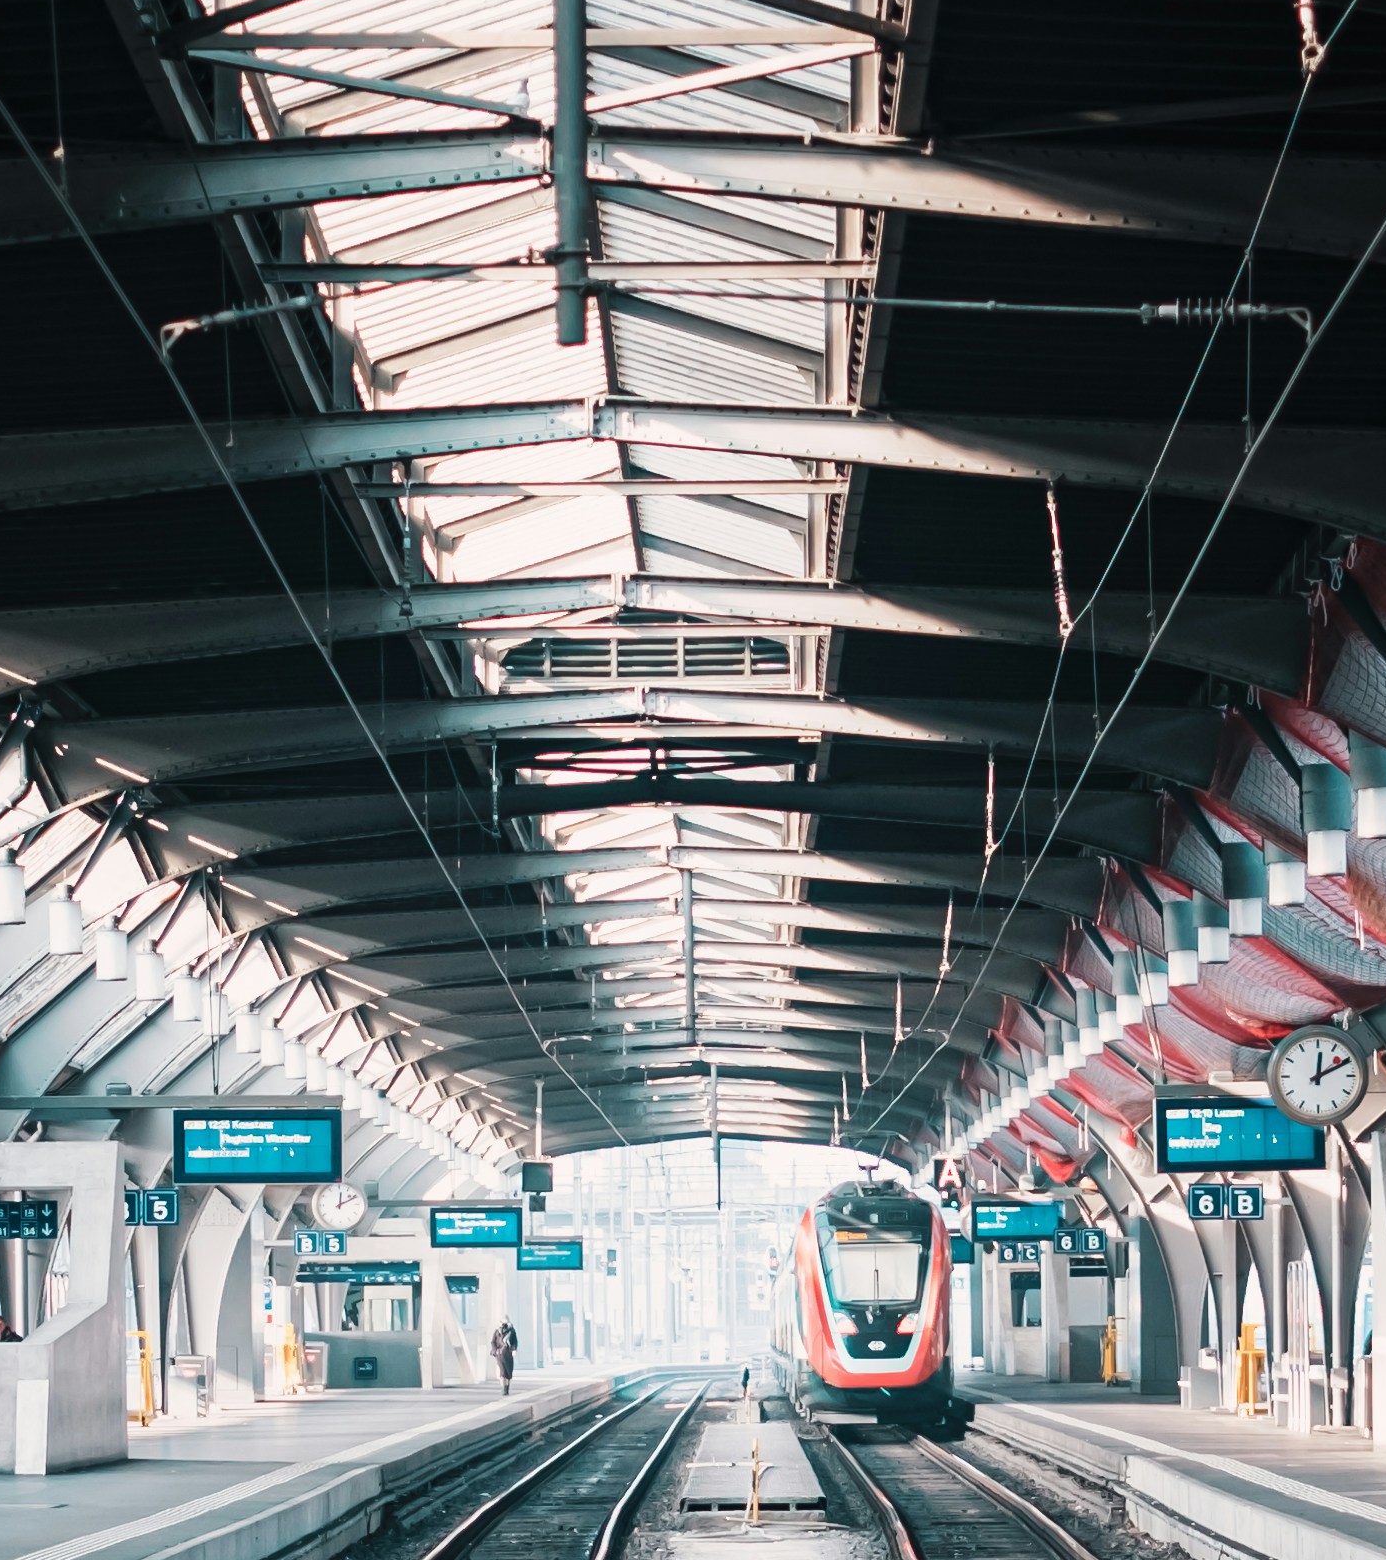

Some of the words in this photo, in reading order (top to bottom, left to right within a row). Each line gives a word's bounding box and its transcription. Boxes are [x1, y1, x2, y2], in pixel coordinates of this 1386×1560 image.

[938, 1158, 962, 1189] A
[153, 1200, 168, 1220] 5
[1198, 1194, 1214, 1215] 6
[1237, 1195, 1254, 1214] B
[300, 1237, 313, 1253] B
[328, 1237, 340, 1253] 5
[1061, 1236, 1072, 1250] 6
[1088, 1236, 1100, 1250] B
[1026, 1248, 1037, 1260] C
